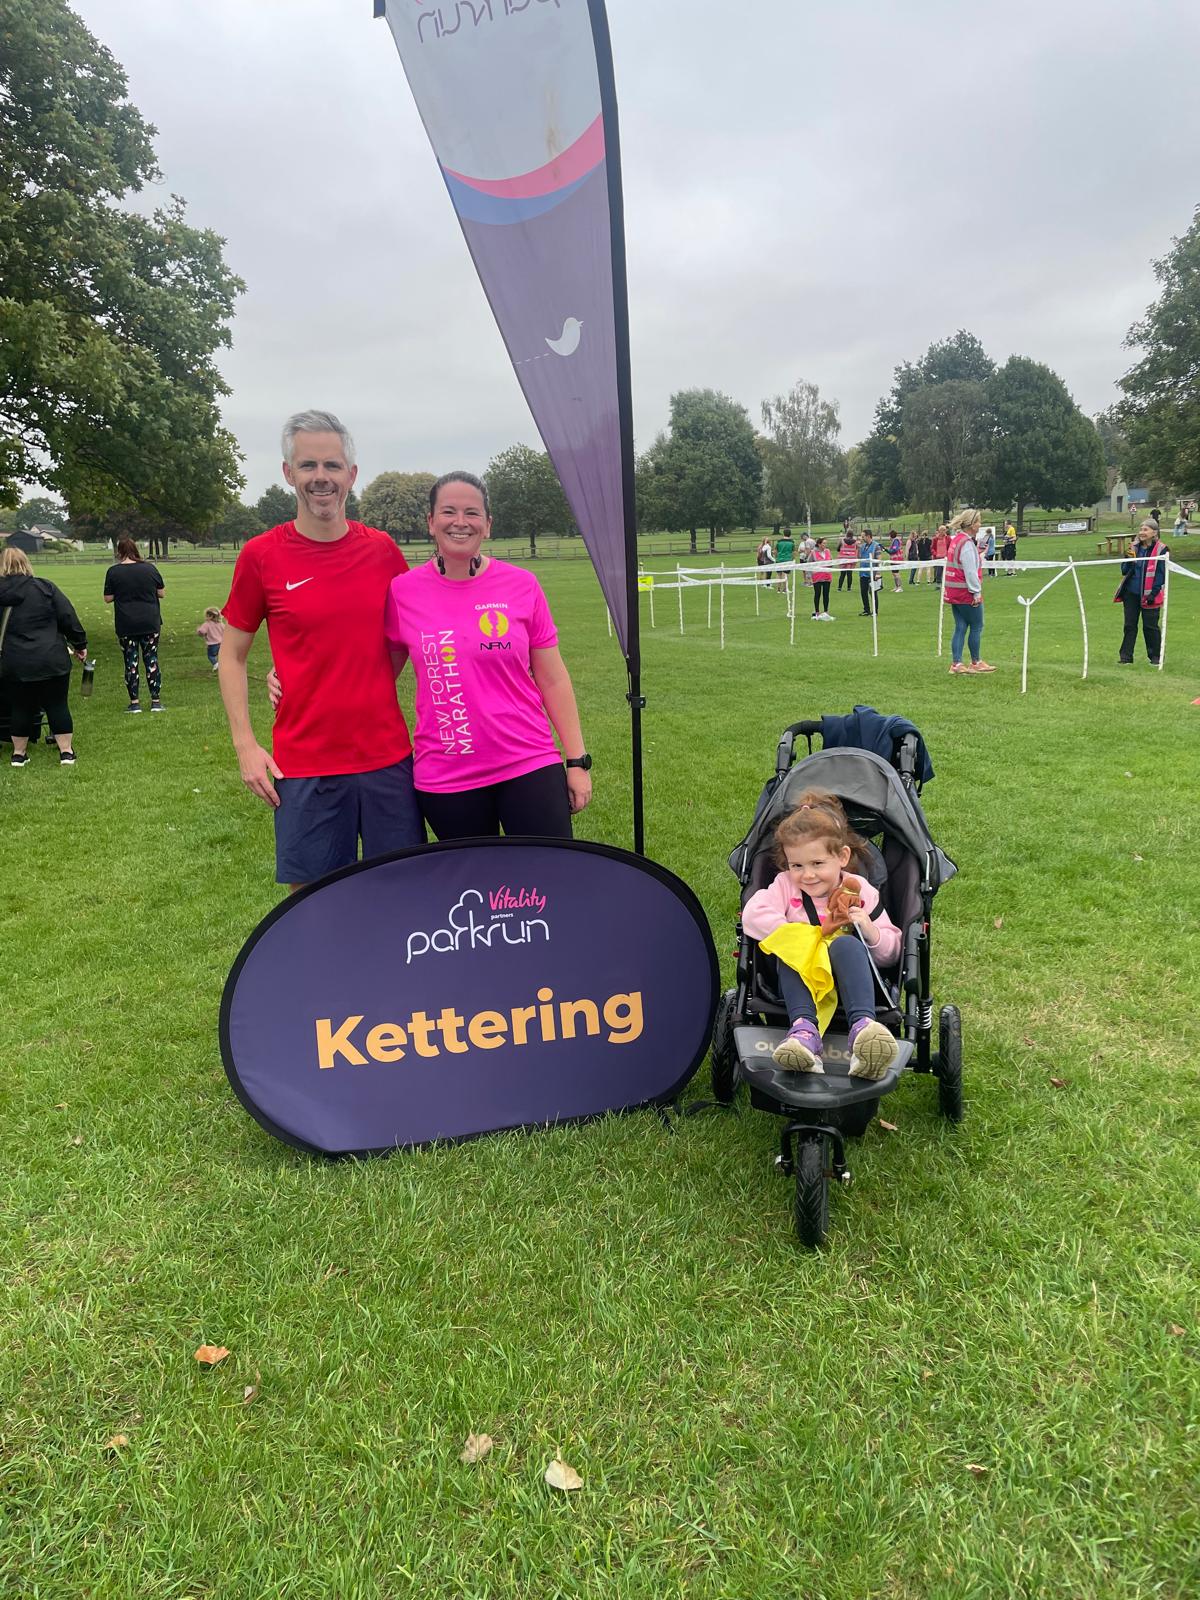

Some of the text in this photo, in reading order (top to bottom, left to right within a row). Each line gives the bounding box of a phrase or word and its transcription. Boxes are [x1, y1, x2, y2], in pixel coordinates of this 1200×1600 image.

[421, 631, 458, 755] NEW FOREST
[438, 630, 475, 754] MARATHON
[489, 884, 547, 914] Vitality
[490, 913, 514, 921] partners
[406, 909, 550, 964] parkrun
[315, 987, 644, 1069] Kettering
